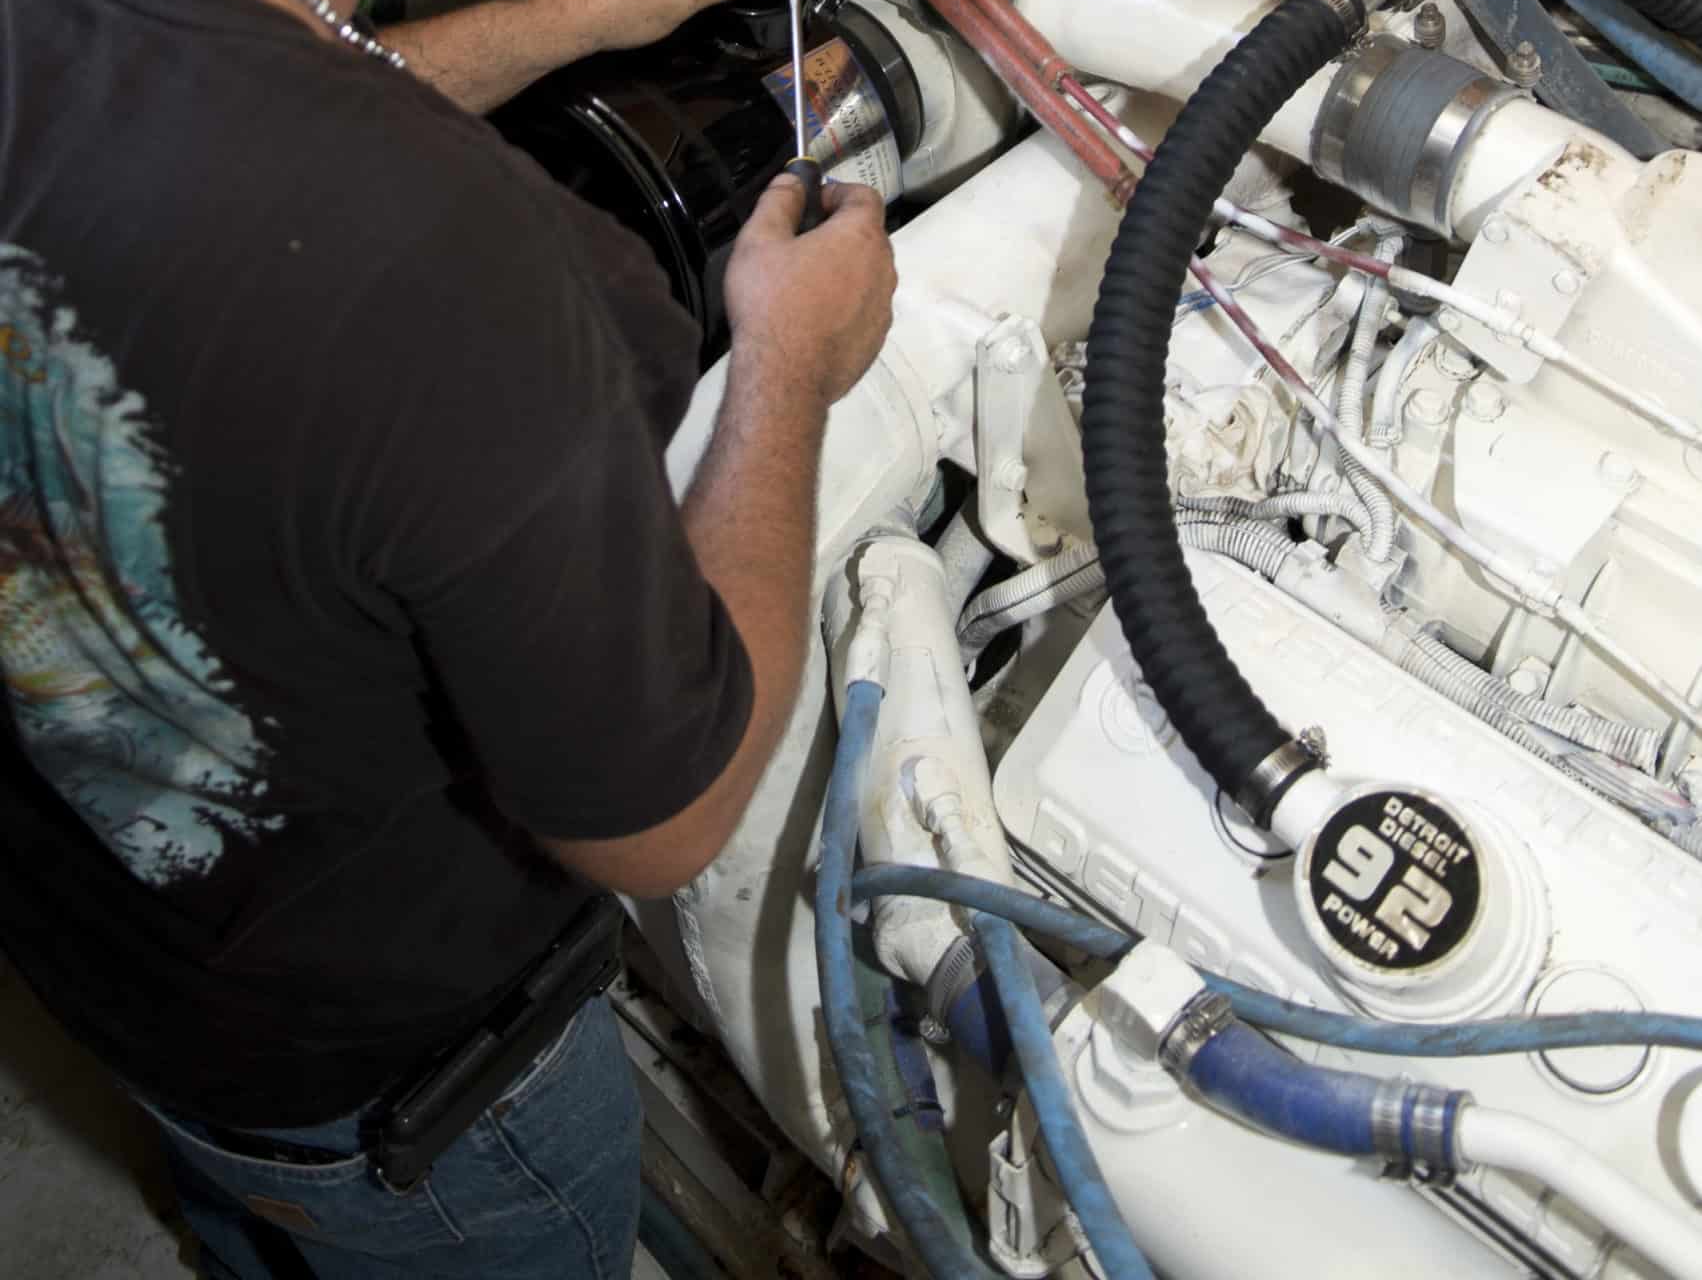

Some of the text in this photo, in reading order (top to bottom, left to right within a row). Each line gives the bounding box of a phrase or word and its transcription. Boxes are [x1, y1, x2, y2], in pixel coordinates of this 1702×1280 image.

[1379, 817, 1447, 878] DIESEL
[1384, 796, 1469, 864] DETROIT
[1321, 824, 1453, 950] 92
[1322, 892, 1399, 960] POWER
